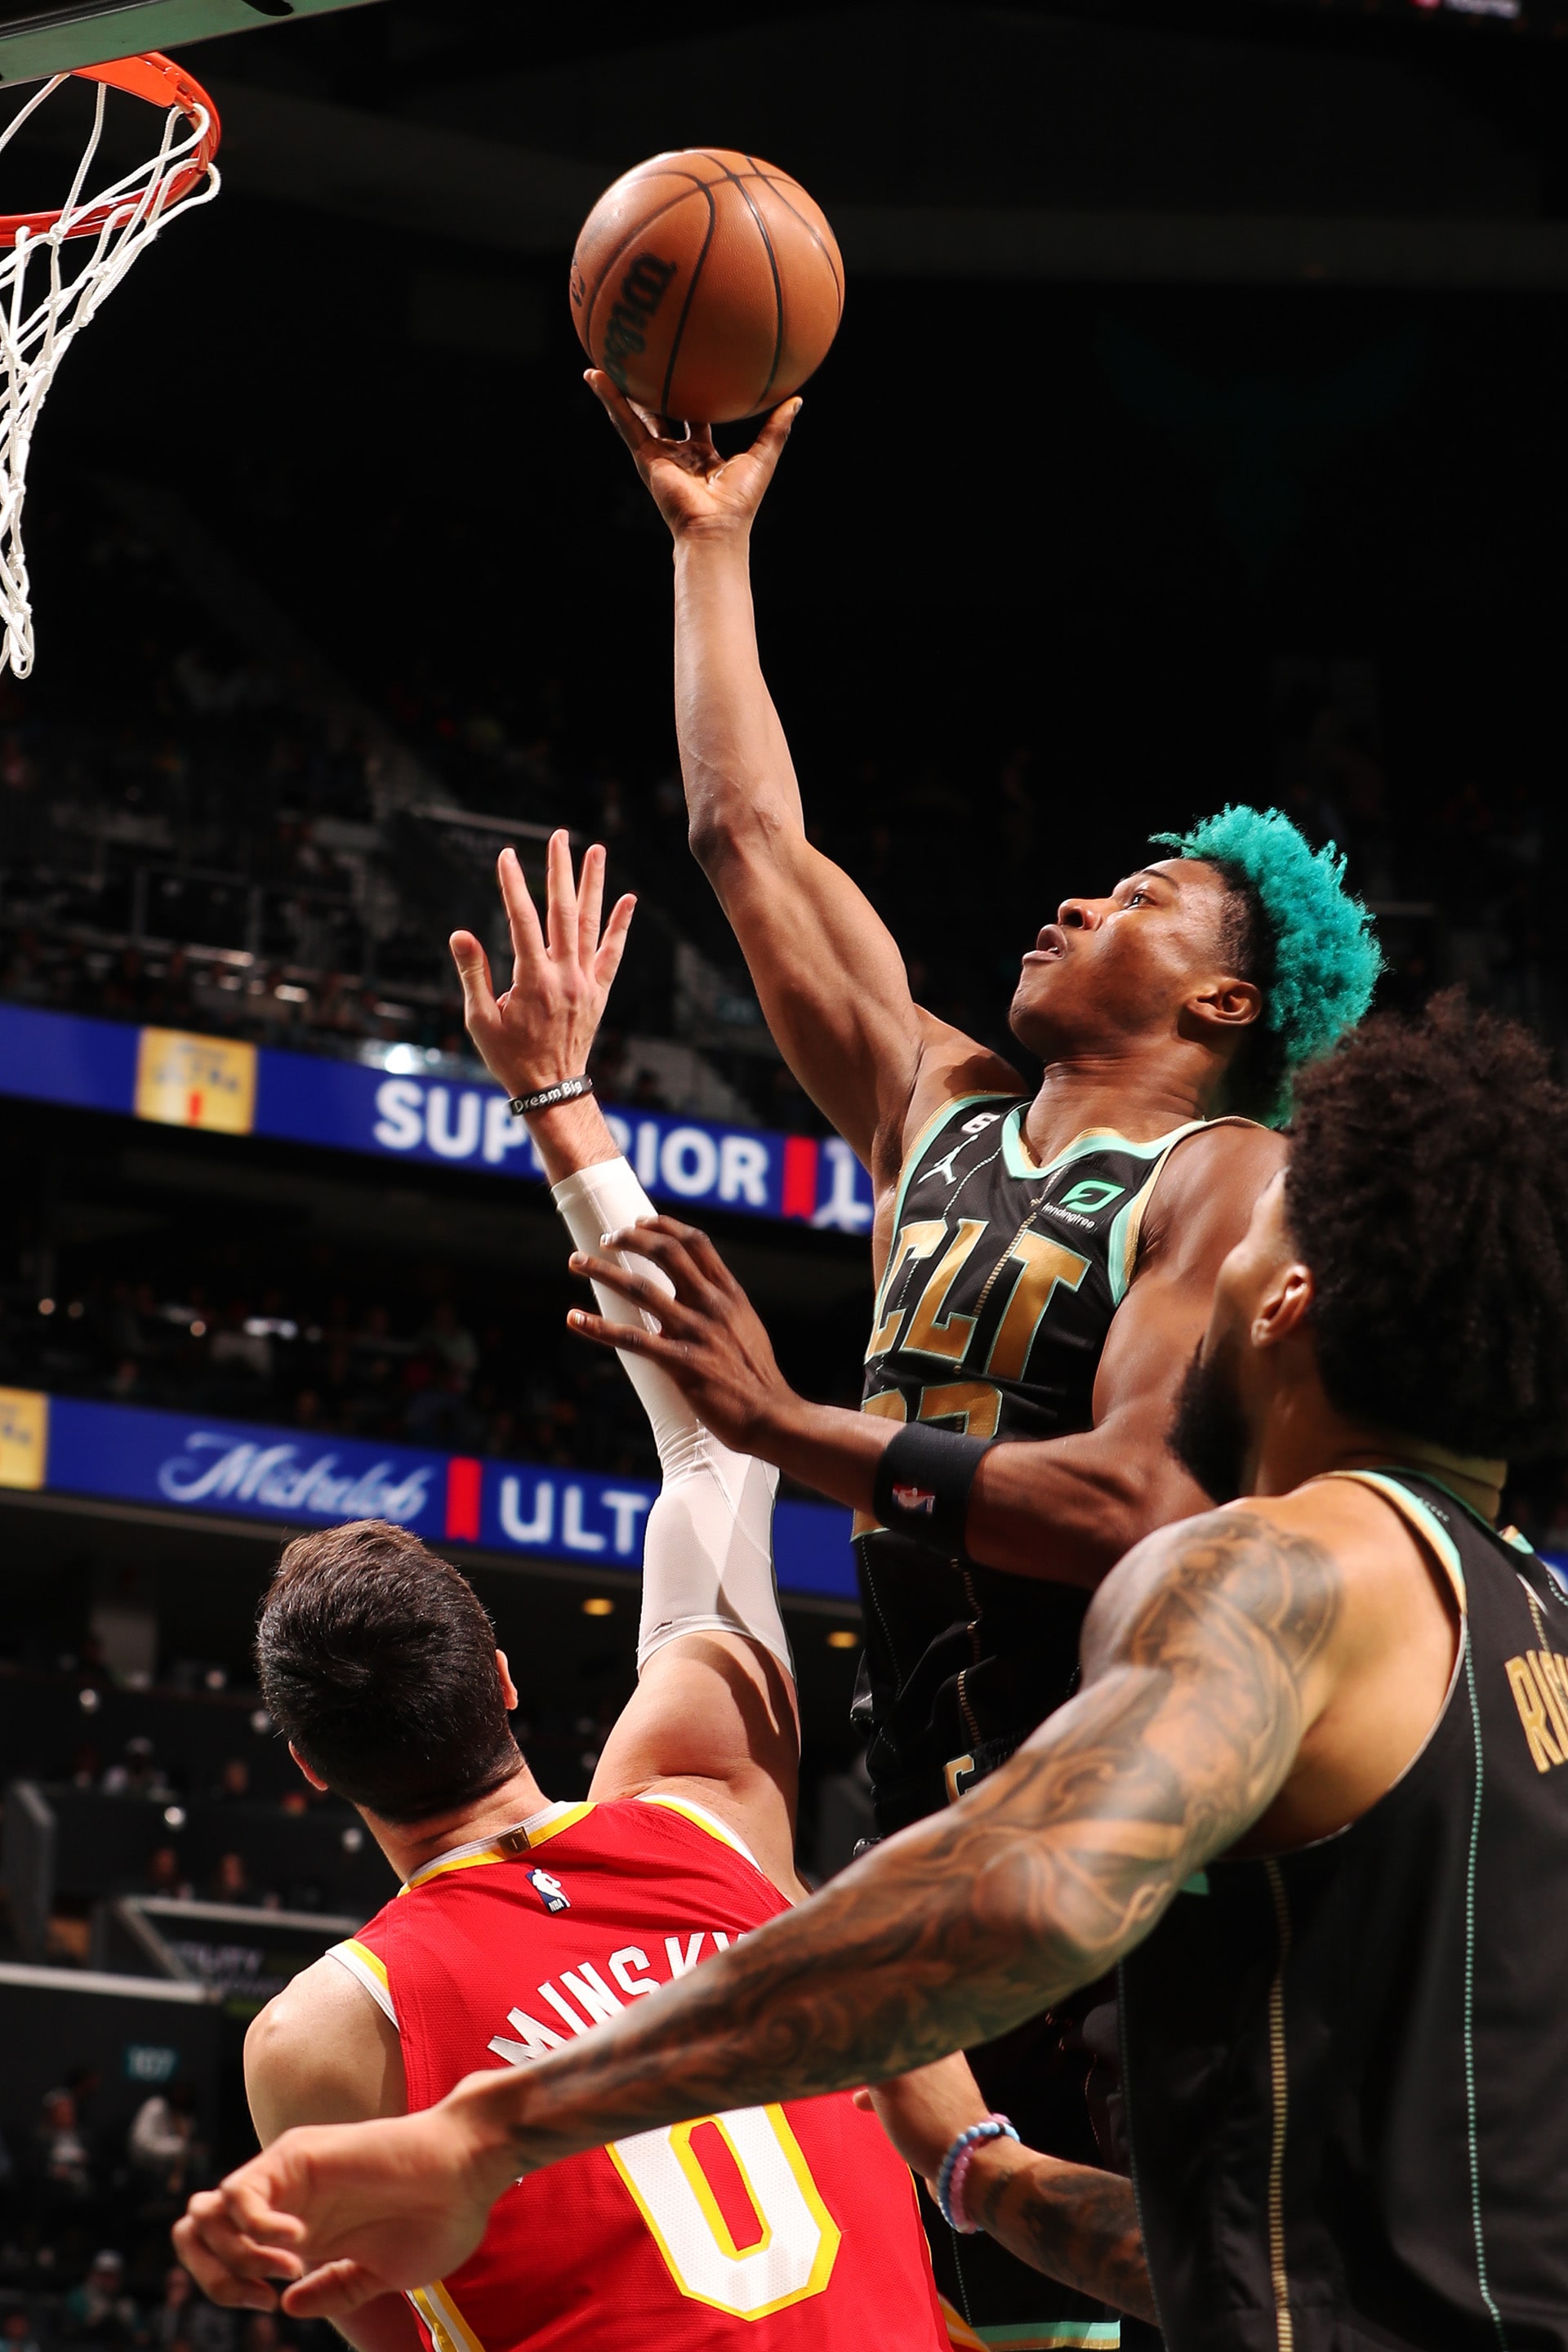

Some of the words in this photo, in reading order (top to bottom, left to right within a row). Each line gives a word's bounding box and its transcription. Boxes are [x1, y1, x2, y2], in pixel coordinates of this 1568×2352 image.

[601, 252, 676, 395] Wilso
[374, 1078, 769, 1207] SUPIOR
[514, 1087, 562, 1112] Dream
[561, 1080, 583, 1099] Big
[864, 1218, 1093, 1382] CLT
[158, 1432, 433, 1524] Michelob
